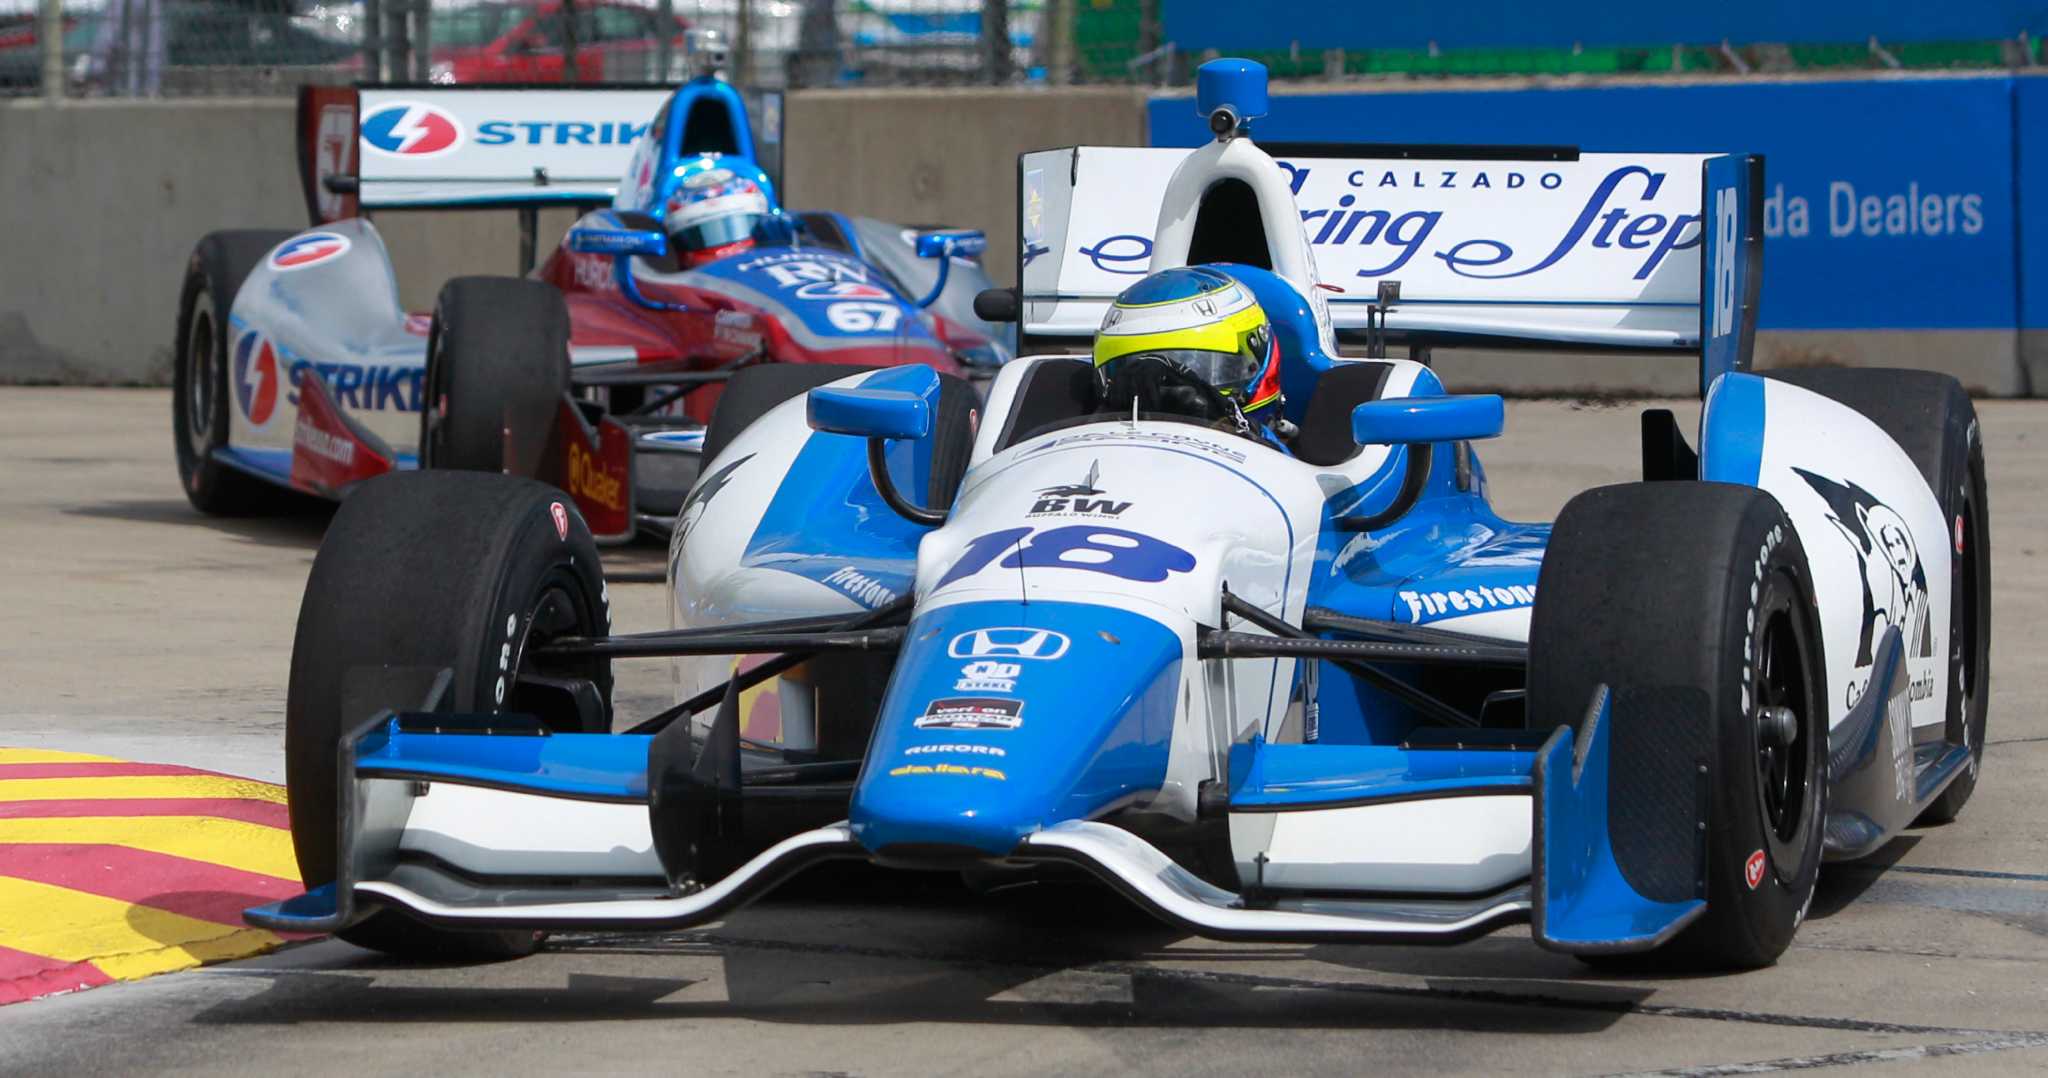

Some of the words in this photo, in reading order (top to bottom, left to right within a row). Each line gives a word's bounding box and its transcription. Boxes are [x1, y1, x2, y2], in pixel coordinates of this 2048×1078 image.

[475, 121, 646, 145] STRIK
[1349, 170, 1563, 190] CALZADO
[1434, 165, 1703, 280] Step
[1831, 182, 1983, 236] Dealers
[1713, 187, 1737, 338] 18
[826, 302, 901, 332] 67
[1030, 498, 1134, 516] BW
[928, 525, 1197, 593] 18
[1740, 524, 1787, 716] Firestone
